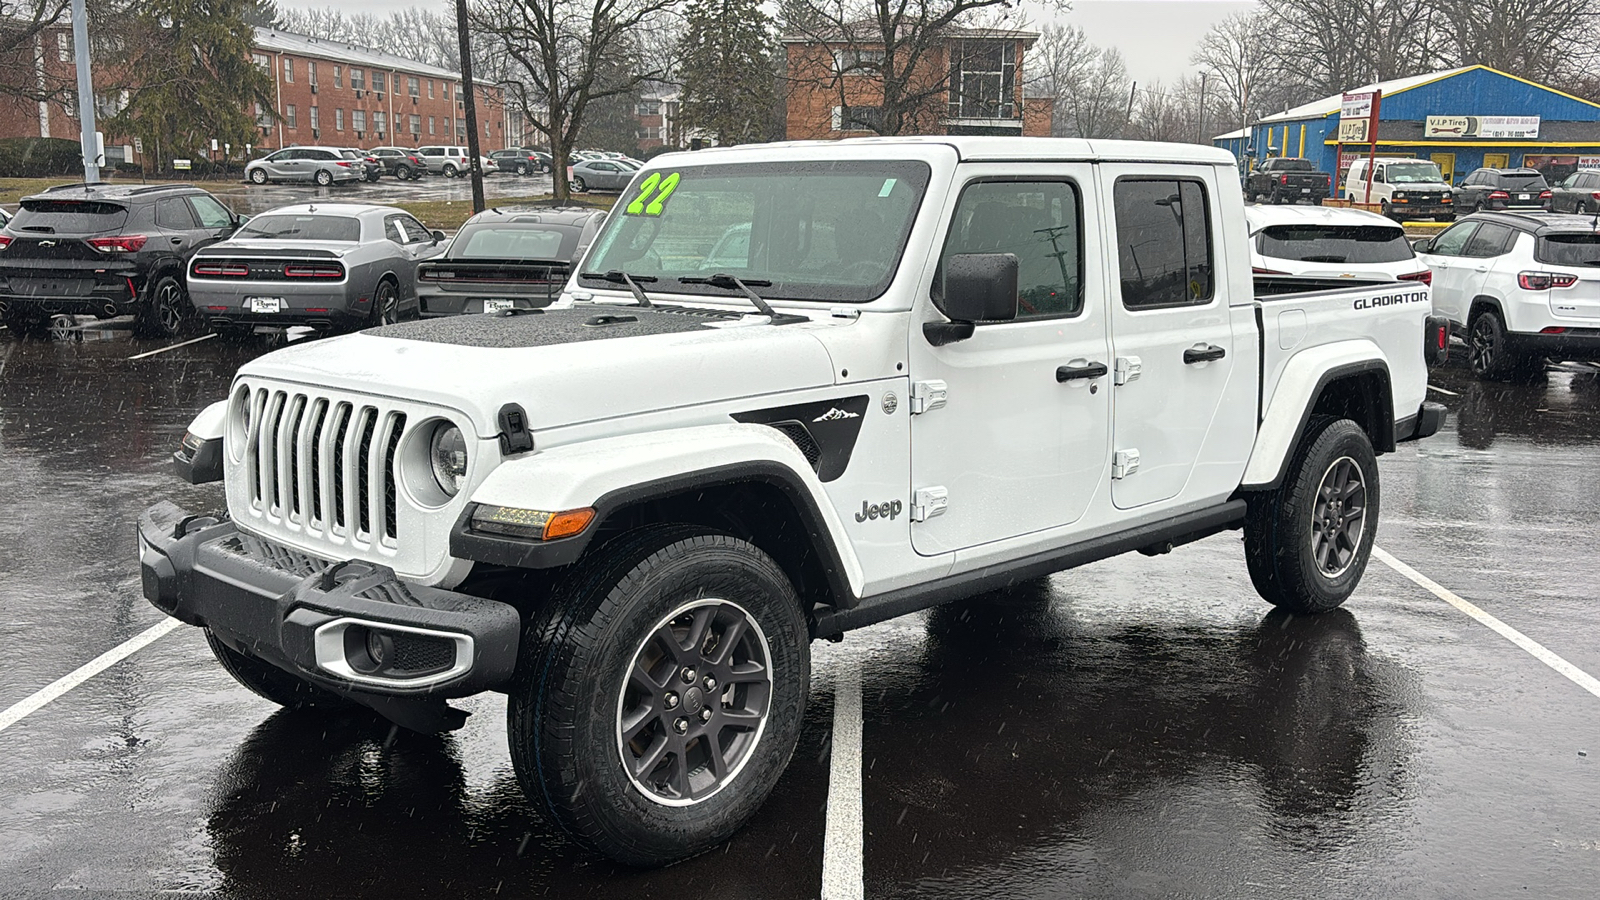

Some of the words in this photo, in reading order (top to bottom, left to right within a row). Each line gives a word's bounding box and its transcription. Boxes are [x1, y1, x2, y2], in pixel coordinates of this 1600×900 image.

[627, 172, 680, 215] 22
[1353, 291, 1429, 311] GLADIATOR
[855, 499, 902, 523] Jeep
